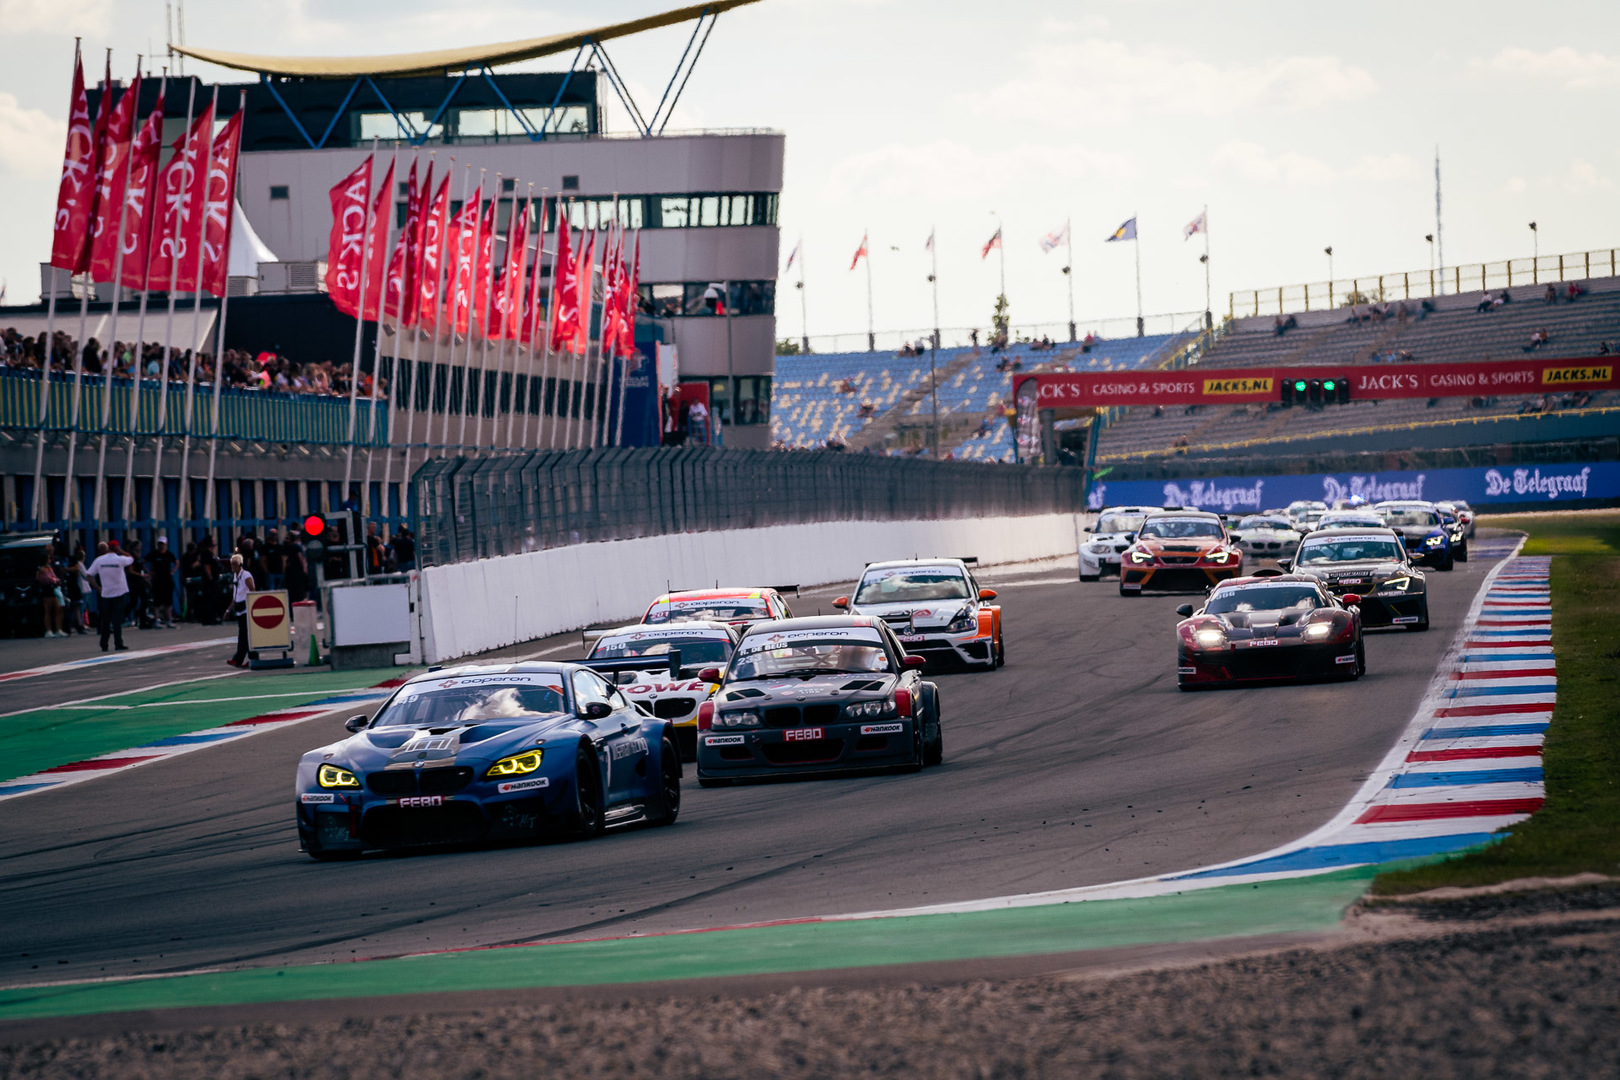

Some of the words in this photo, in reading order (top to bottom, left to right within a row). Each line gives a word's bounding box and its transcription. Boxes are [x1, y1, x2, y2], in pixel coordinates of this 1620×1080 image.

[1358, 374, 1419, 390] JACK'S
[1430, 373, 1475, 386] CASINO
[1479, 372, 1489, 385] &
[1491, 370, 1534, 384] SPORTS
[1546, 367, 1608, 381] JACKS.NL
[1036, 383, 1081, 398] CK'S
[1092, 384, 1137, 395] CASINO
[1139, 383, 1150, 394] &
[1153, 382, 1195, 394] SPORTS
[1208, 379, 1269, 392] JACKS.NL
[1486, 468, 1511, 496] De
[1513, 466, 1591, 498] Telegraaf
[1163, 482, 1189, 508] De
[1323, 475, 1348, 503] De
[617, 681, 704, 694] OWE
[785, 728, 822, 741] FEBO
[869, 724, 901, 733] HANKOOK
[712, 736, 742, 745] HANKOOK
[510, 779, 547, 790] HANKOOK
[399, 795, 442, 808] FEBO
